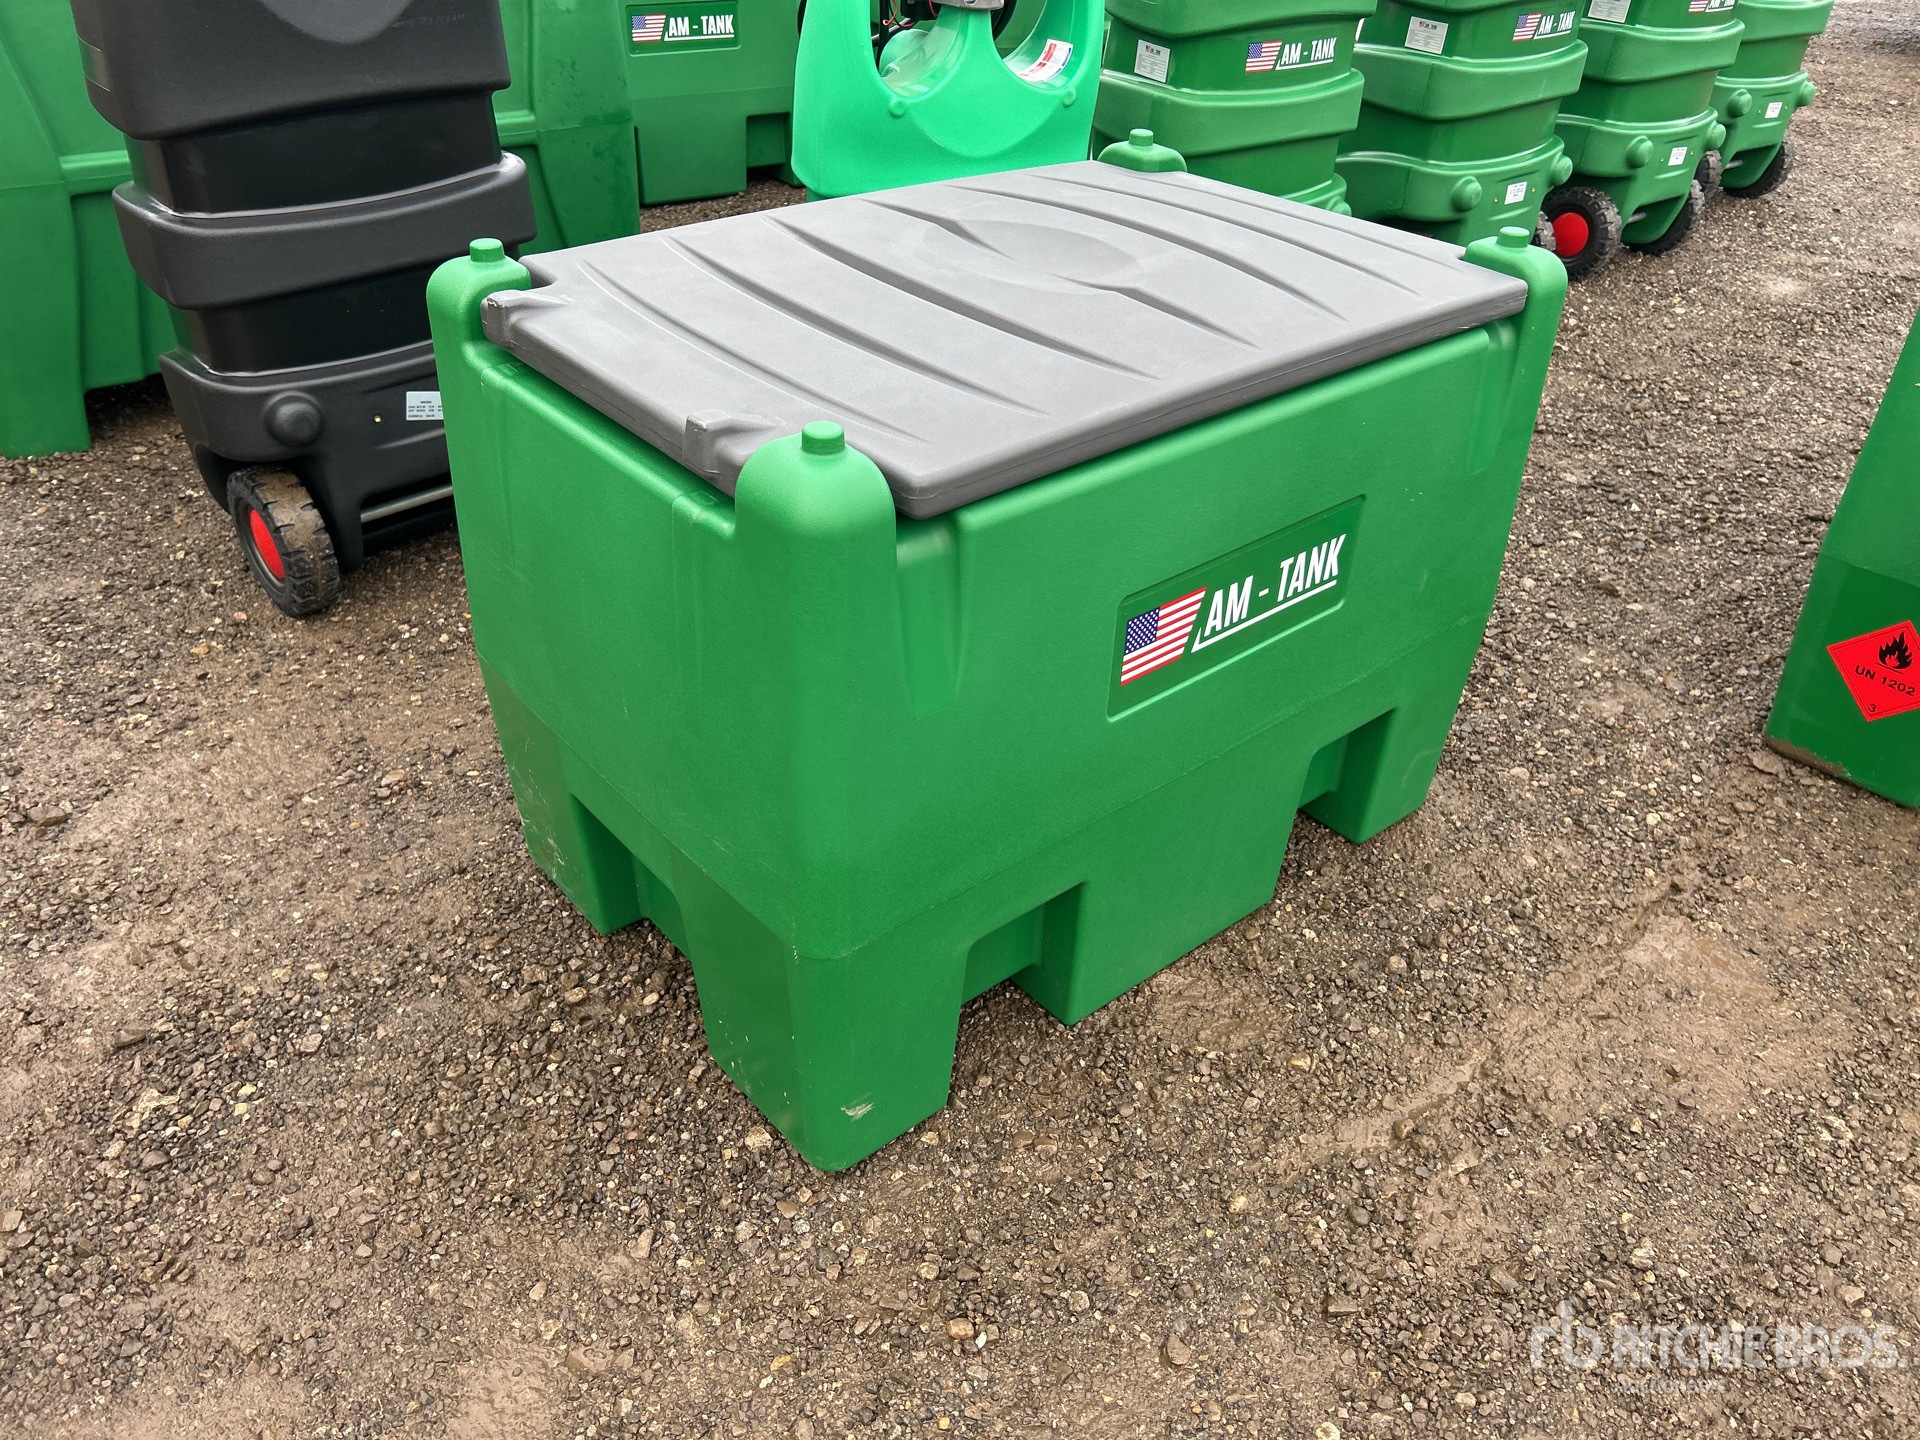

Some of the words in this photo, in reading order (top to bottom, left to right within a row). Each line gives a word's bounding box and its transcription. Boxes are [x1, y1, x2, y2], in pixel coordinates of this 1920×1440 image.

[668, 16, 690, 37] AM
[700, 14, 735, 35] TANK
[1538, 14, 1555, 36] AM
[1557, 10, 1576, 32] TANK
[1281, 42, 1302, 65] AM
[1310, 37, 1338, 61] TANK
[1203, 575, 1254, 637] AM
[1277, 533, 1347, 602] TANK
[1855, 664, 1876, 680] UN
[1881, 676, 1916, 697] 1202
[1868, 703, 1877, 713] 3
